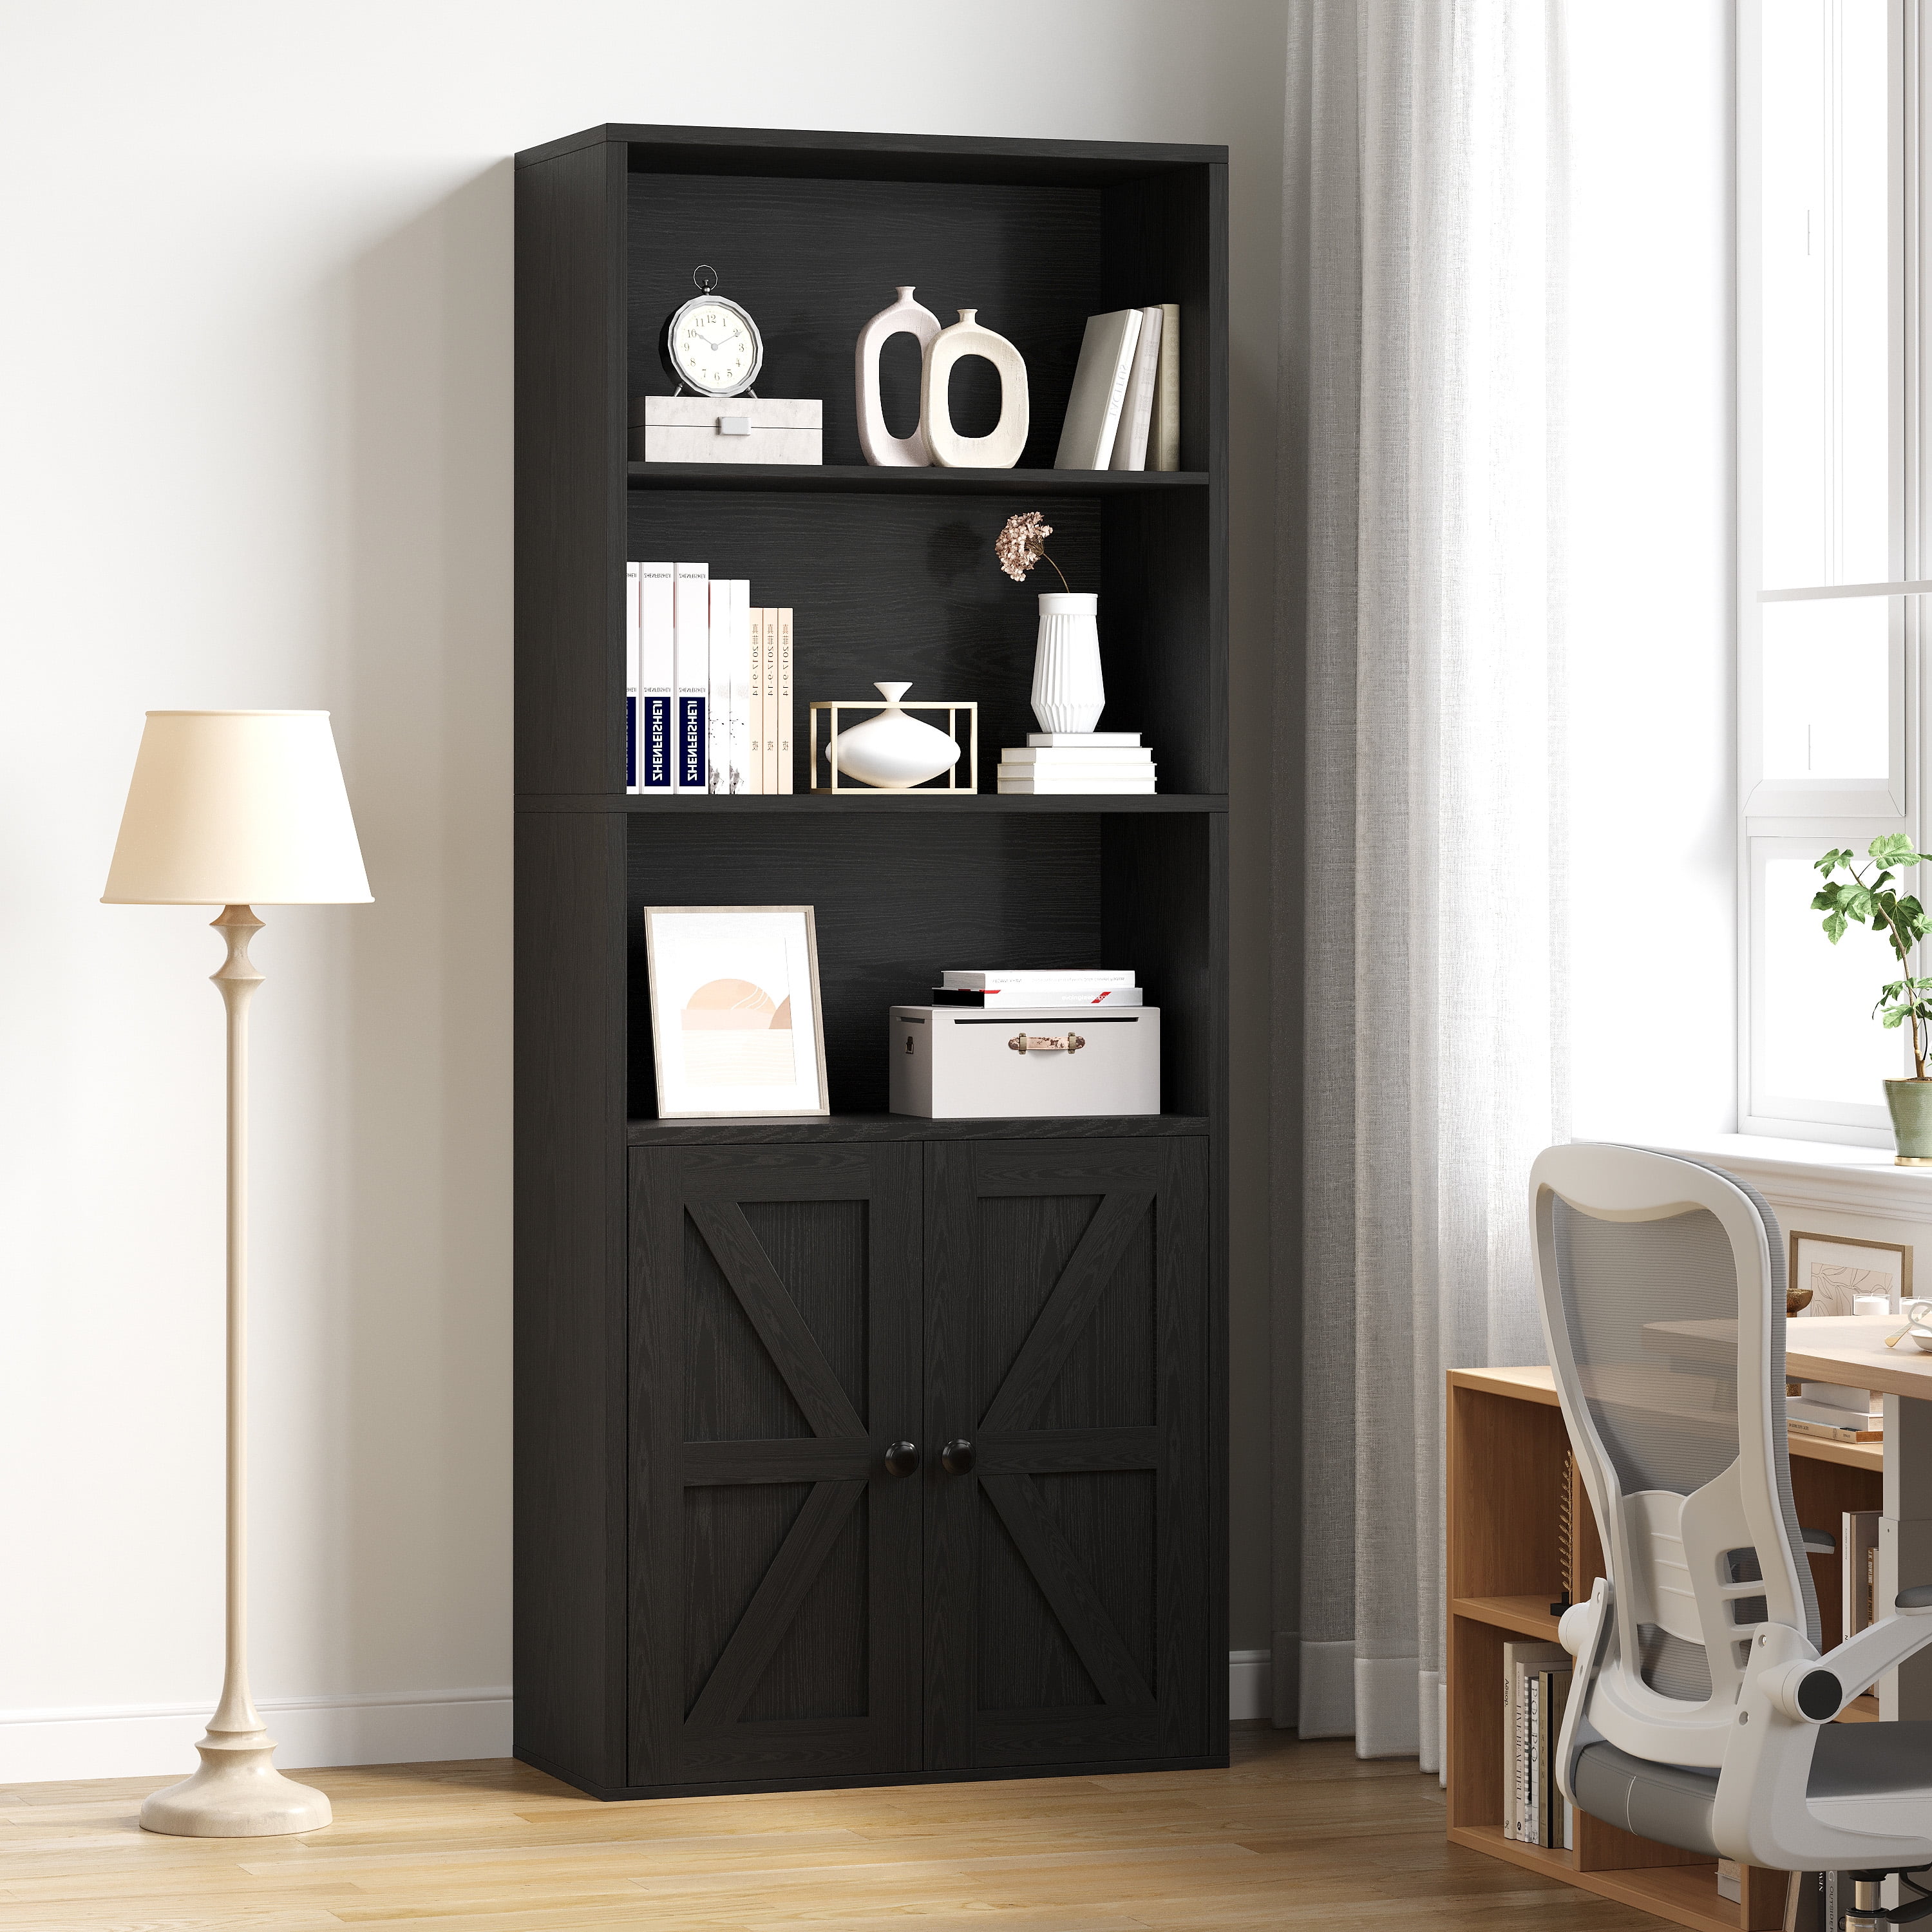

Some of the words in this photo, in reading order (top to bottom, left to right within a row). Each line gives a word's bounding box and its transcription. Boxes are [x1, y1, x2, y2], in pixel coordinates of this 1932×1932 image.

[696, 318, 705, 327] 11
[707, 314, 716, 323] 12
[723, 318, 726, 327] 1
[687, 329, 697, 337] 10
[733, 328, 740, 337] 2
[684, 343, 690, 352] 9
[739, 343, 744, 352] 3
[690, 357, 696, 366] 8
[735, 357, 741, 367] 4
[702, 369, 706, 378] 7
[714, 372, 720, 381] 6
[727, 368, 732, 378] 5
